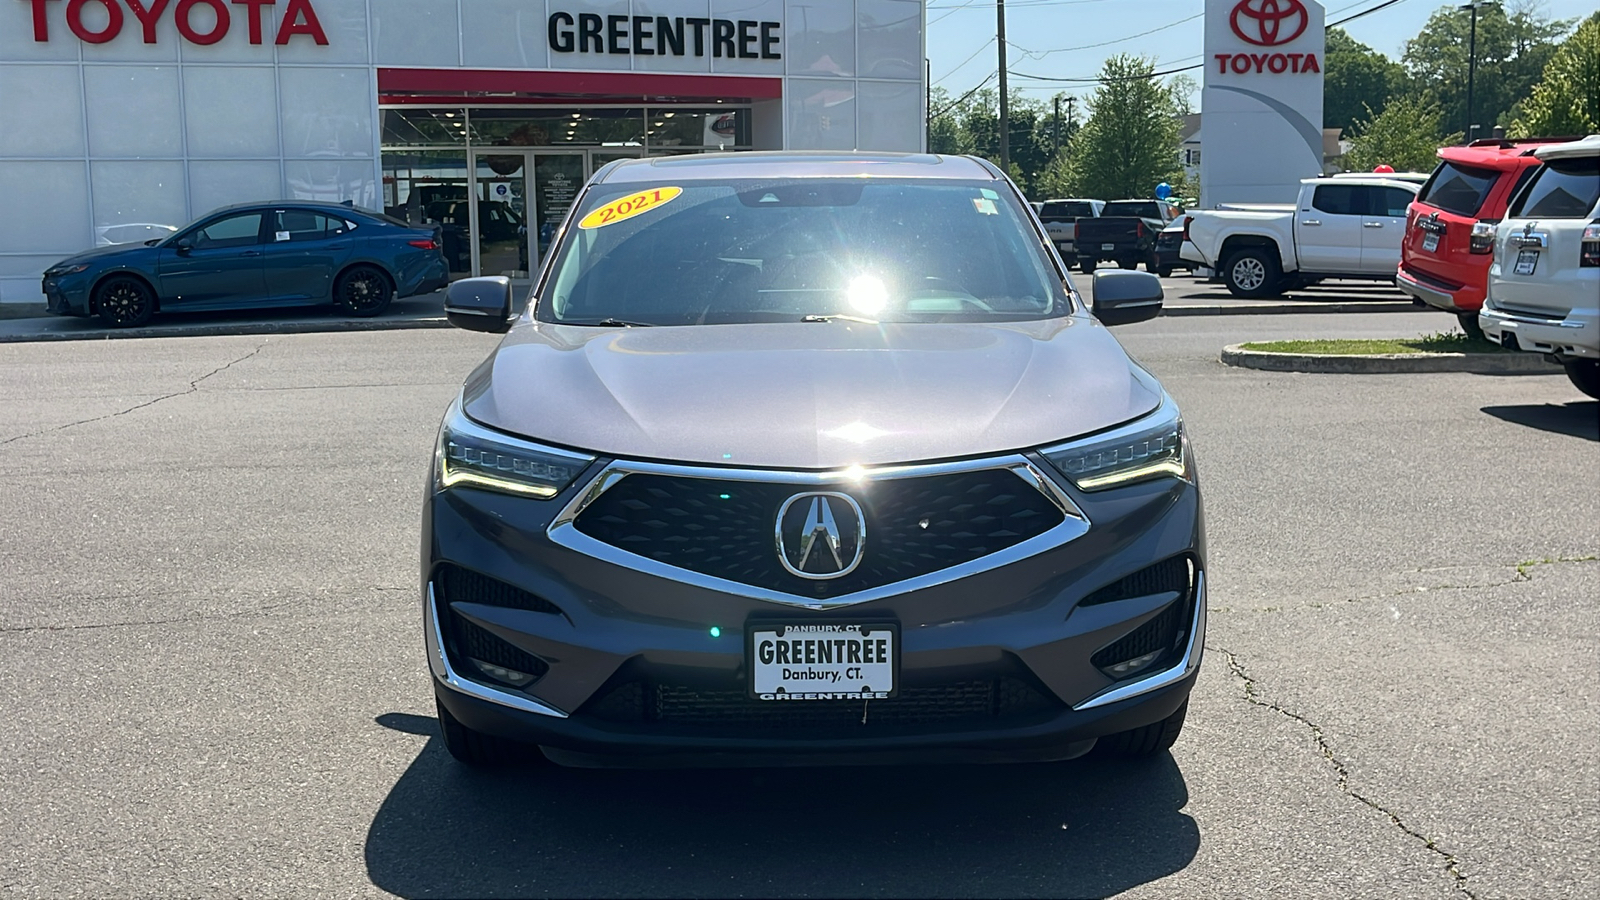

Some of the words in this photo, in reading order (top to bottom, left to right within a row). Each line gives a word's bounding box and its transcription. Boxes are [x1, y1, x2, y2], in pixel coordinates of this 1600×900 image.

[18, 0, 329, 46] TOYOTA
[548, 12, 781, 60] GREENTREE
[1214, 53, 1320, 74] TOYOTA
[599, 190, 664, 223] 2021
[785, 625, 842, 633] DANBURY,
[759, 639, 887, 665] GREENTREE
[783, 667, 842, 683] Danbury,
[846, 667, 863, 680] CT.
[760, 692, 888, 700] GREENTREE
